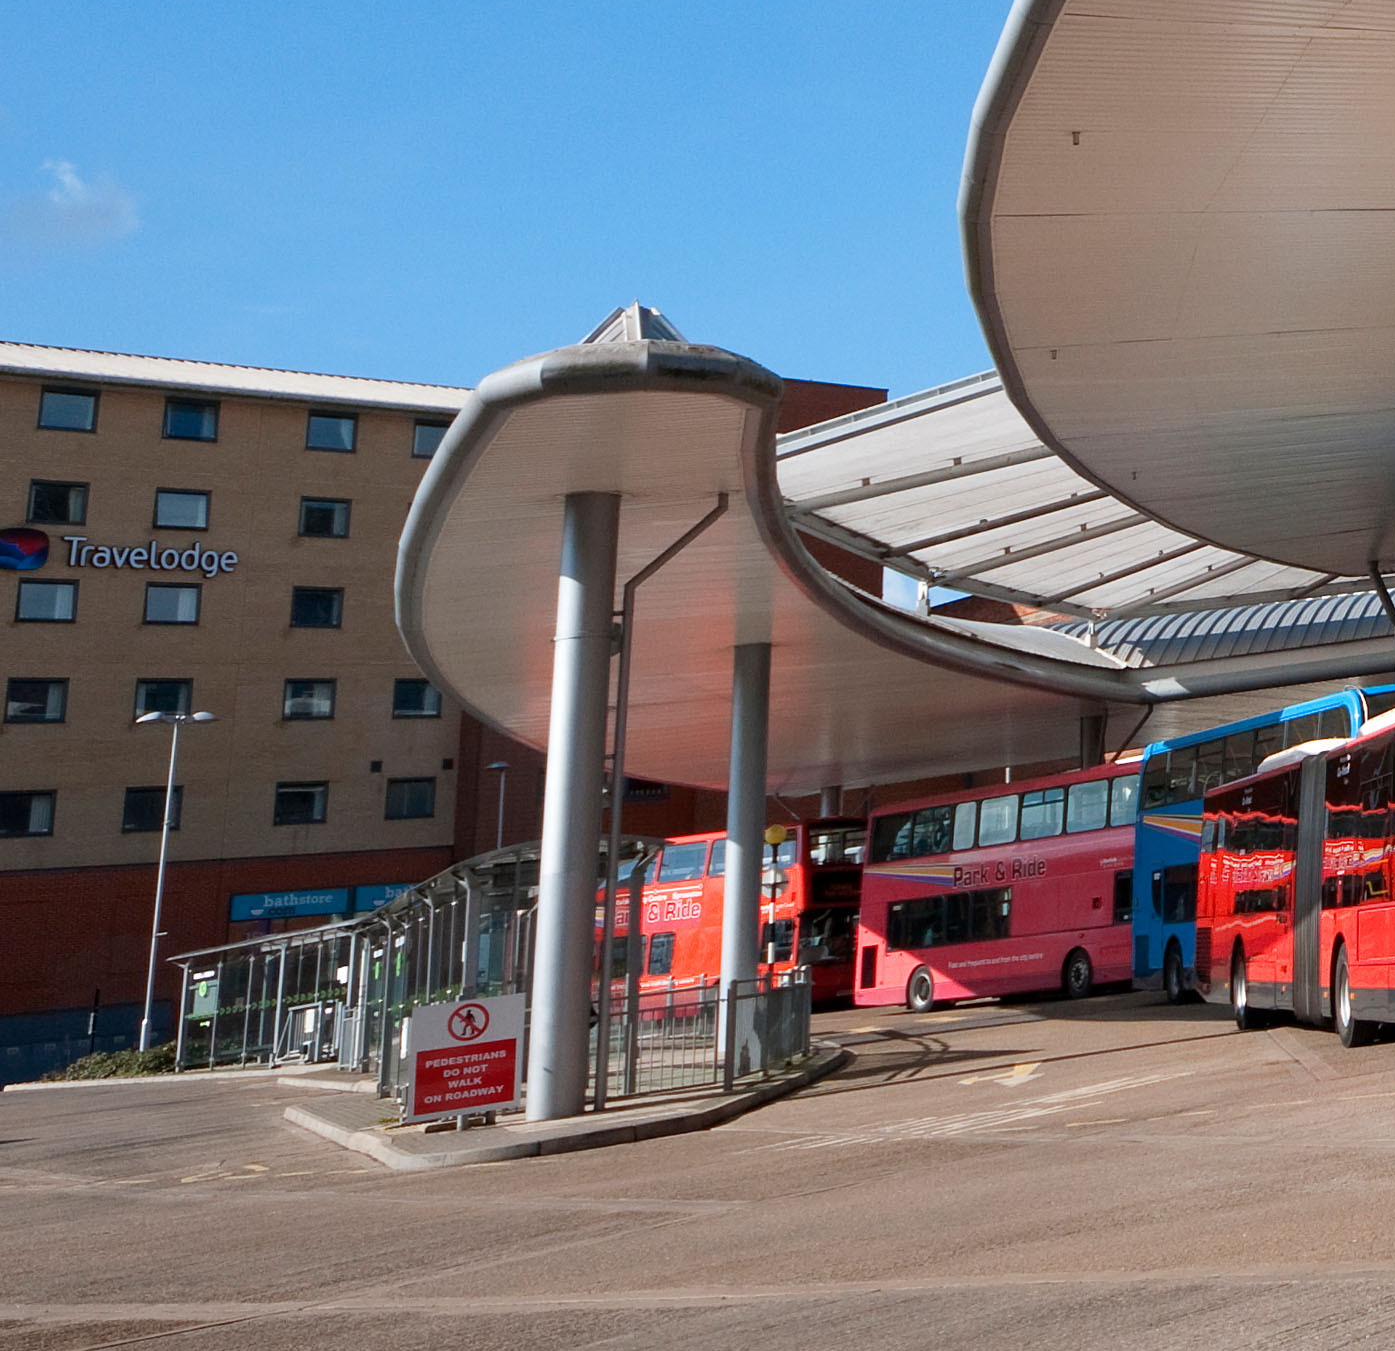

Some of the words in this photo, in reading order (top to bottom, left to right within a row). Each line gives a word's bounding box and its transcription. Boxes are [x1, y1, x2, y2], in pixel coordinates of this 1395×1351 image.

[63, 535, 239, 579] Travelodge
[952, 864, 991, 889] Park
[994, 860, 1006, 883] &
[1011, 856, 1047, 882] Ride
[263, 893, 334, 908] bathstore
[646, 902, 660, 923] &
[664, 898, 702, 921] Ride
[425, 1050, 507, 1069] PEDESTRIANS
[443, 1069, 460, 1078] DO
[463, 1064, 488, 1075] NOT
[448, 1076, 482, 1088] WALK
[424, 1095, 442, 1104] ON
[445, 1084, 504, 1101] ROADWAY
